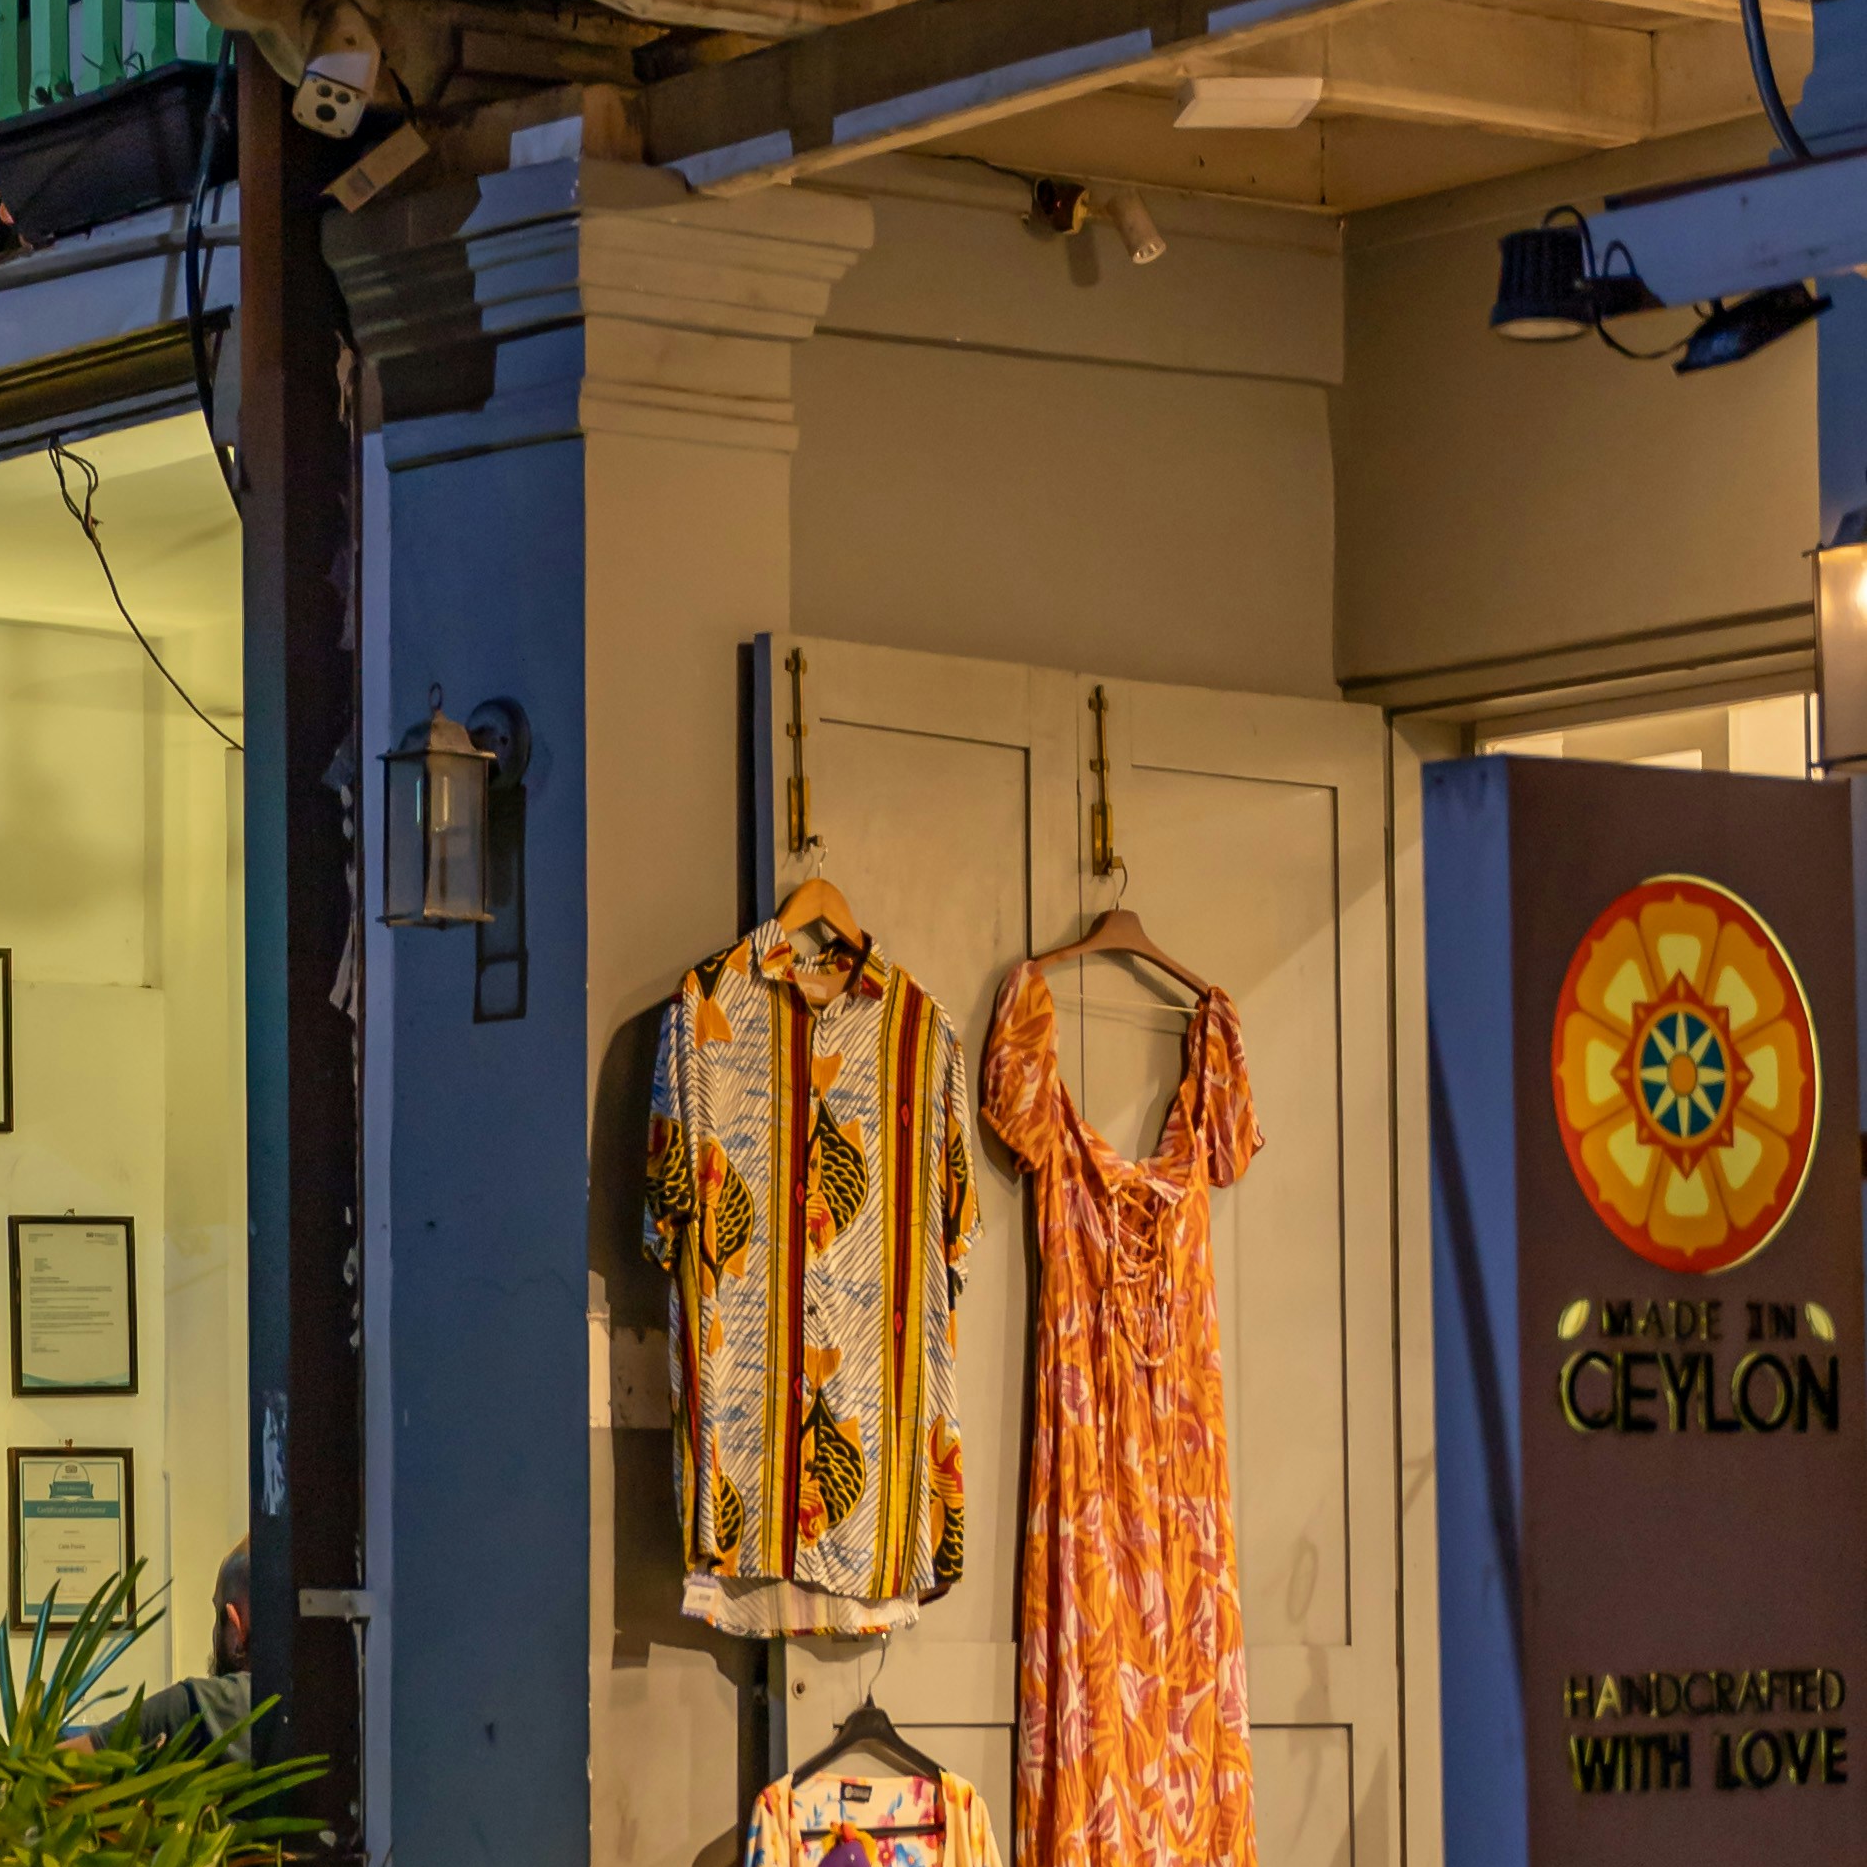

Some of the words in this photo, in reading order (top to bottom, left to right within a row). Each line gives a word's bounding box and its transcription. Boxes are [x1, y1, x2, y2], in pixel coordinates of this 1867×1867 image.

[1600, 1298, 1722, 1341] MADE
[1746, 1301, 1797, 1341] IN
[1559, 1350, 1840, 1433] CEYLON
[1563, 1667, 1846, 1720] HANDCRAFTED
[1570, 1731, 1691, 1794] WITH
[1715, 1726, 1848, 1790] LOVE
